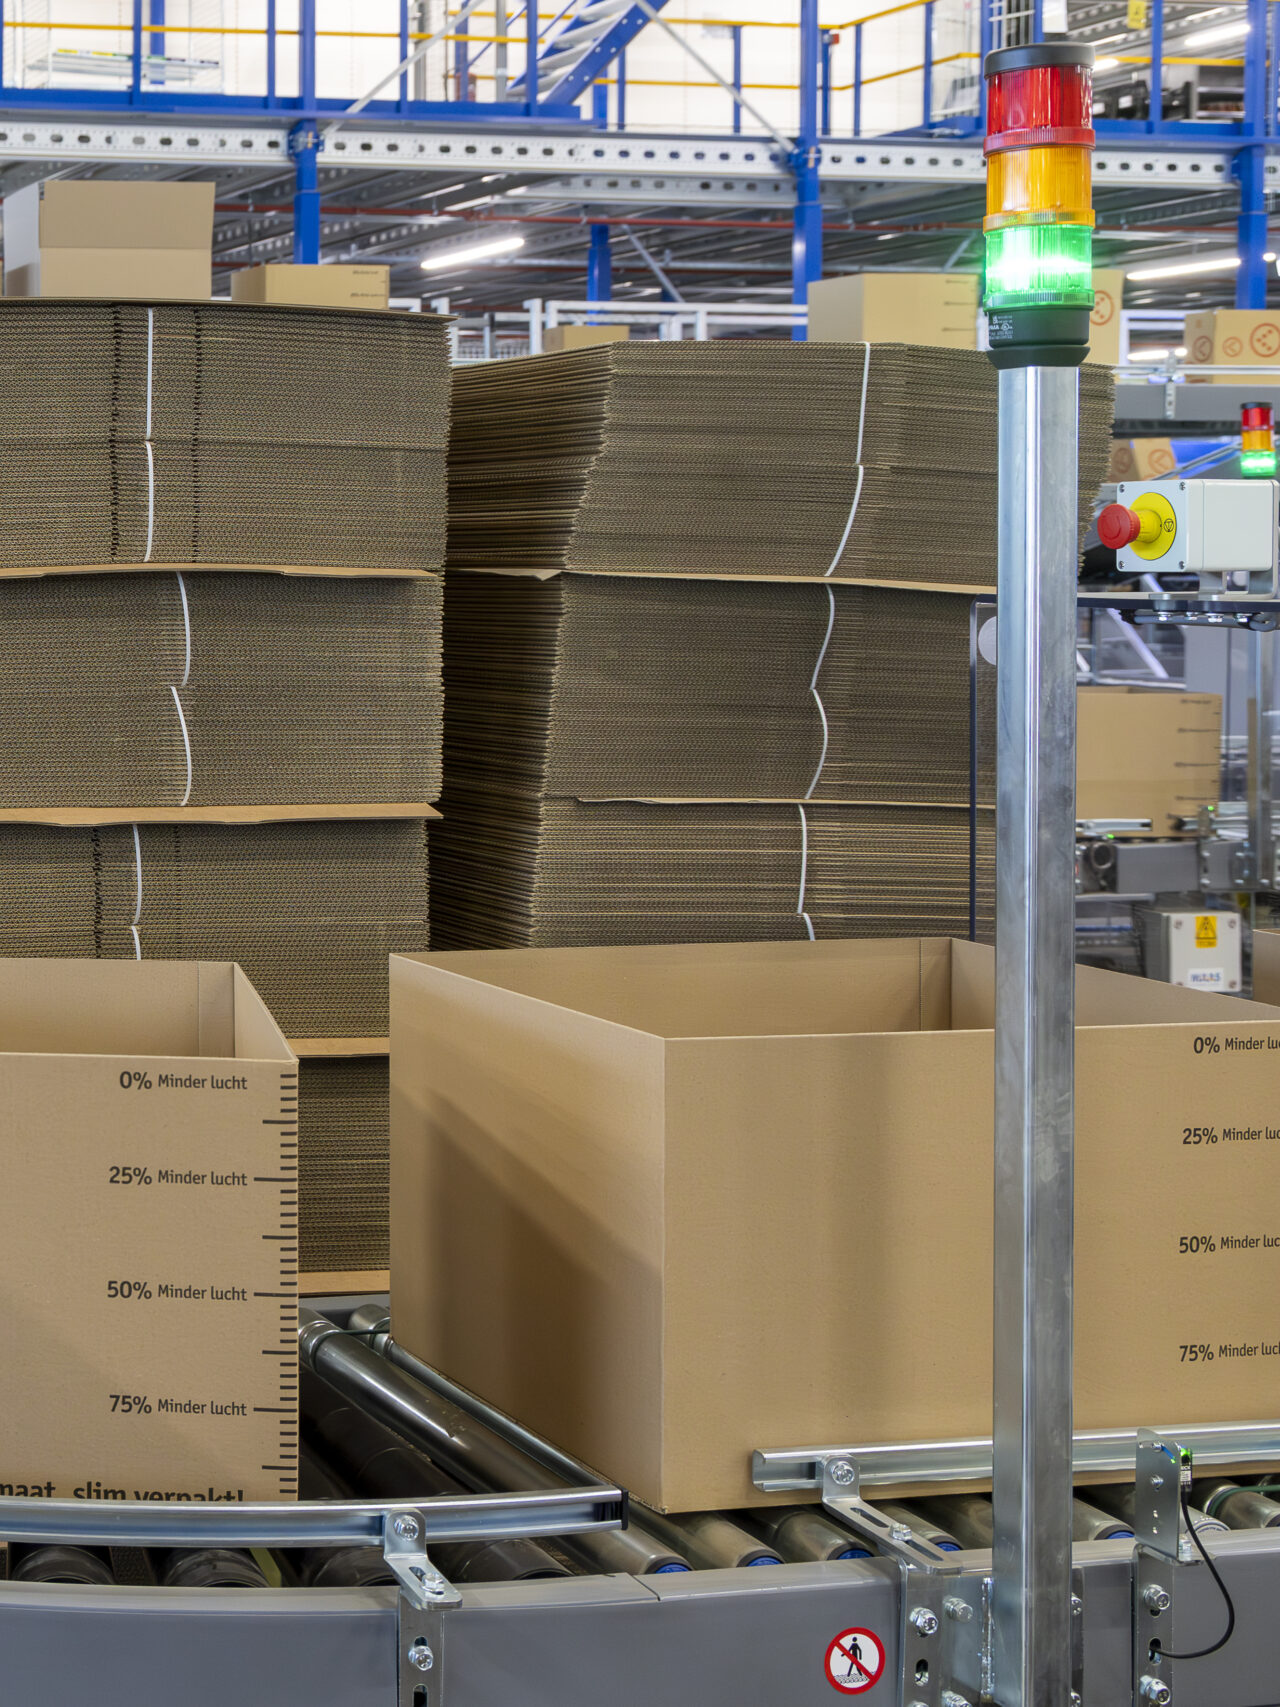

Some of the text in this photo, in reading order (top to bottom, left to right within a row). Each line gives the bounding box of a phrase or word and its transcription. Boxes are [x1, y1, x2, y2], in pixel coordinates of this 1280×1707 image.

[1193, 1036, 1280, 1055] 0% Minder lu
[119, 1070, 248, 1090] 0% Minder lucht
[1182, 1126, 1219, 1145] 25%
[1222, 1126, 1263, 1142] Minder
[108, 1165, 248, 1187] 25% Minder lucht
[1179, 1235, 1216, 1254] 50%
[1220, 1234, 1261, 1250] Minder
[107, 1280, 248, 1302] 50% Minder lucht
[1179, 1341, 1280, 1363] 75% Minder luc
[109, 1394, 248, 1417] 75% Minder lucht
[72, 1480, 127, 1501] slim
